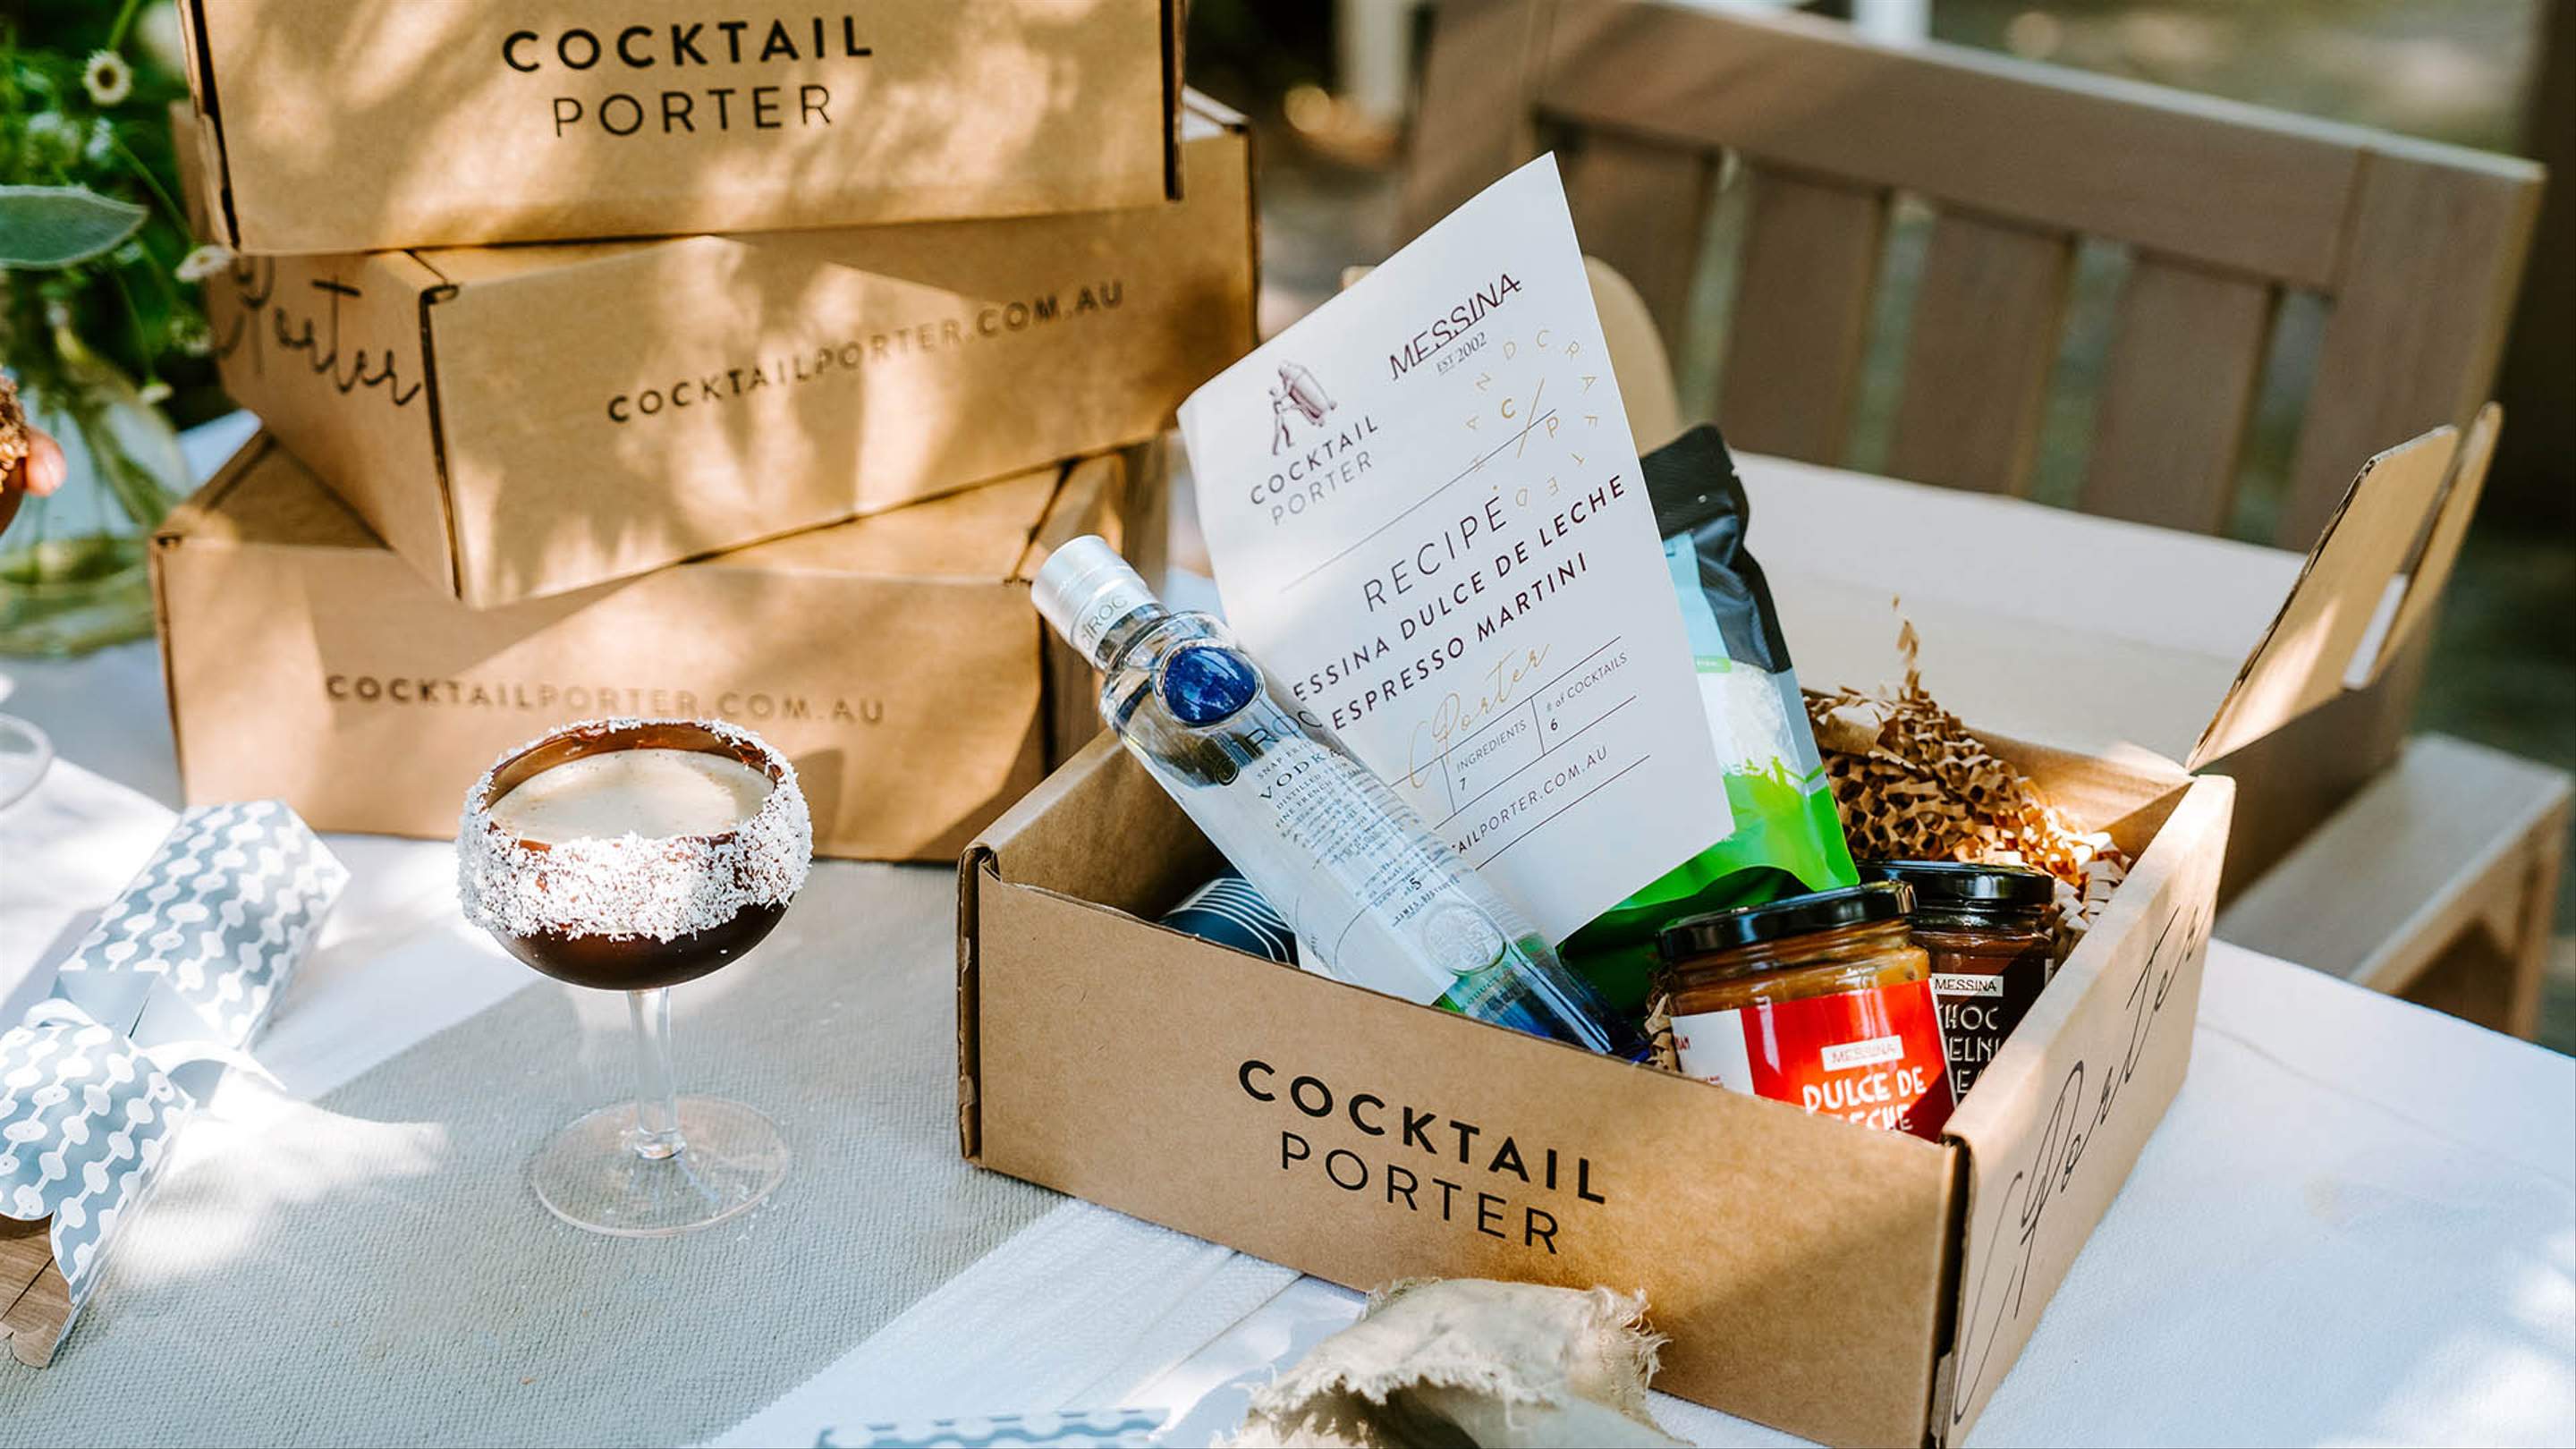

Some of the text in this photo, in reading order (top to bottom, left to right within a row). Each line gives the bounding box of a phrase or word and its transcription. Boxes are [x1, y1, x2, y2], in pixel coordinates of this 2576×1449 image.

[503, 15, 872, 72] COCKTAIL
[553, 84, 831, 138] PORTER
[607, 279, 1124, 423] COCKTAILPORTER.COM.AU
[1389, 273, 1522, 382] MESSINA
[1436, 331, 1488, 376] EST 2002
[1250, 415, 1379, 505] COCKTAIL
[1271, 450, 1373, 526] PORTER
[1362, 496, 1507, 613] RECIPE
[1292, 474, 1625, 702] ESSINA DULCE DE LECHE
[1331, 551, 1588, 731] ESPRESSO MARTINI
[326, 674, 886, 724] COCKTAILPORTER.COM.AU
[1555, 693, 1565, 709] of
[1566, 652, 1628, 699] COCKTAILS
[1455, 720, 1528, 774] INGREDIENTS
[1549, 718, 1559, 732] 6
[1452, 746, 1607, 854] AILPORTER.COM.AU
[1459, 777, 1467, 792] 7
[1934, 978, 1998, 993] MESSINA
[1802, 1072, 1892, 1114] DULCE
[1896, 1066, 1928, 1098] DE
[1846, 1104, 1913, 1131] ECHE
[1238, 1059, 1606, 1205] COCKTAIL
[1282, 1131, 1559, 1255] PORTER
